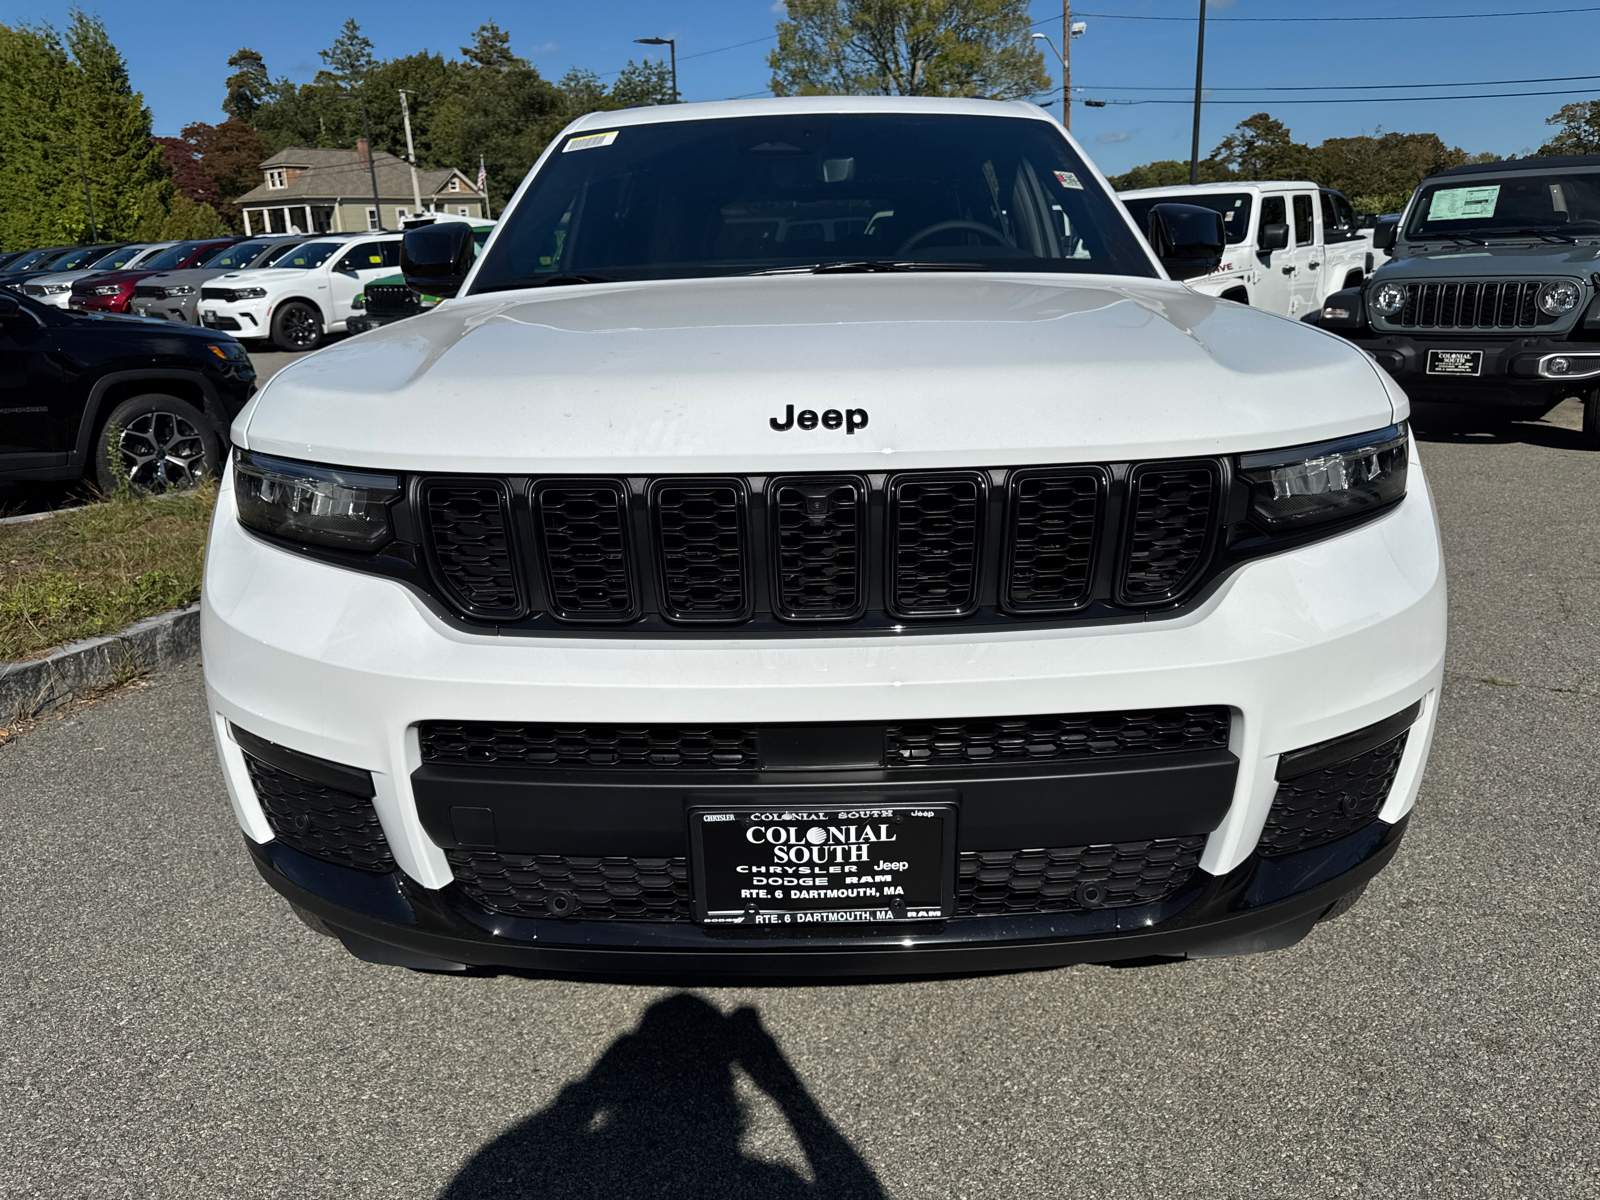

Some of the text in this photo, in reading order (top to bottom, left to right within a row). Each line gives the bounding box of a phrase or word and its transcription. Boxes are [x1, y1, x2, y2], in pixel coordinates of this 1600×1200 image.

[769, 404, 869, 435] Jeep
[703, 814, 736, 822] CHRYSLER
[750, 809, 894, 821] COLONIAL SOUTH
[910, 810, 935, 818] Jeep
[746, 823, 897, 845] COLONIAL
[773, 843, 871, 864] SOUTH
[735, 860, 909, 874] CHRYSLER Jeep
[752, 874, 893, 886] DODGE RAM
[741, 885, 905, 899] RTE. 6 DARTMOUTH, MA
[755, 910, 894, 924] RTE. 6 DARTMOUTH, MA
[907, 910, 942, 918] RAM
